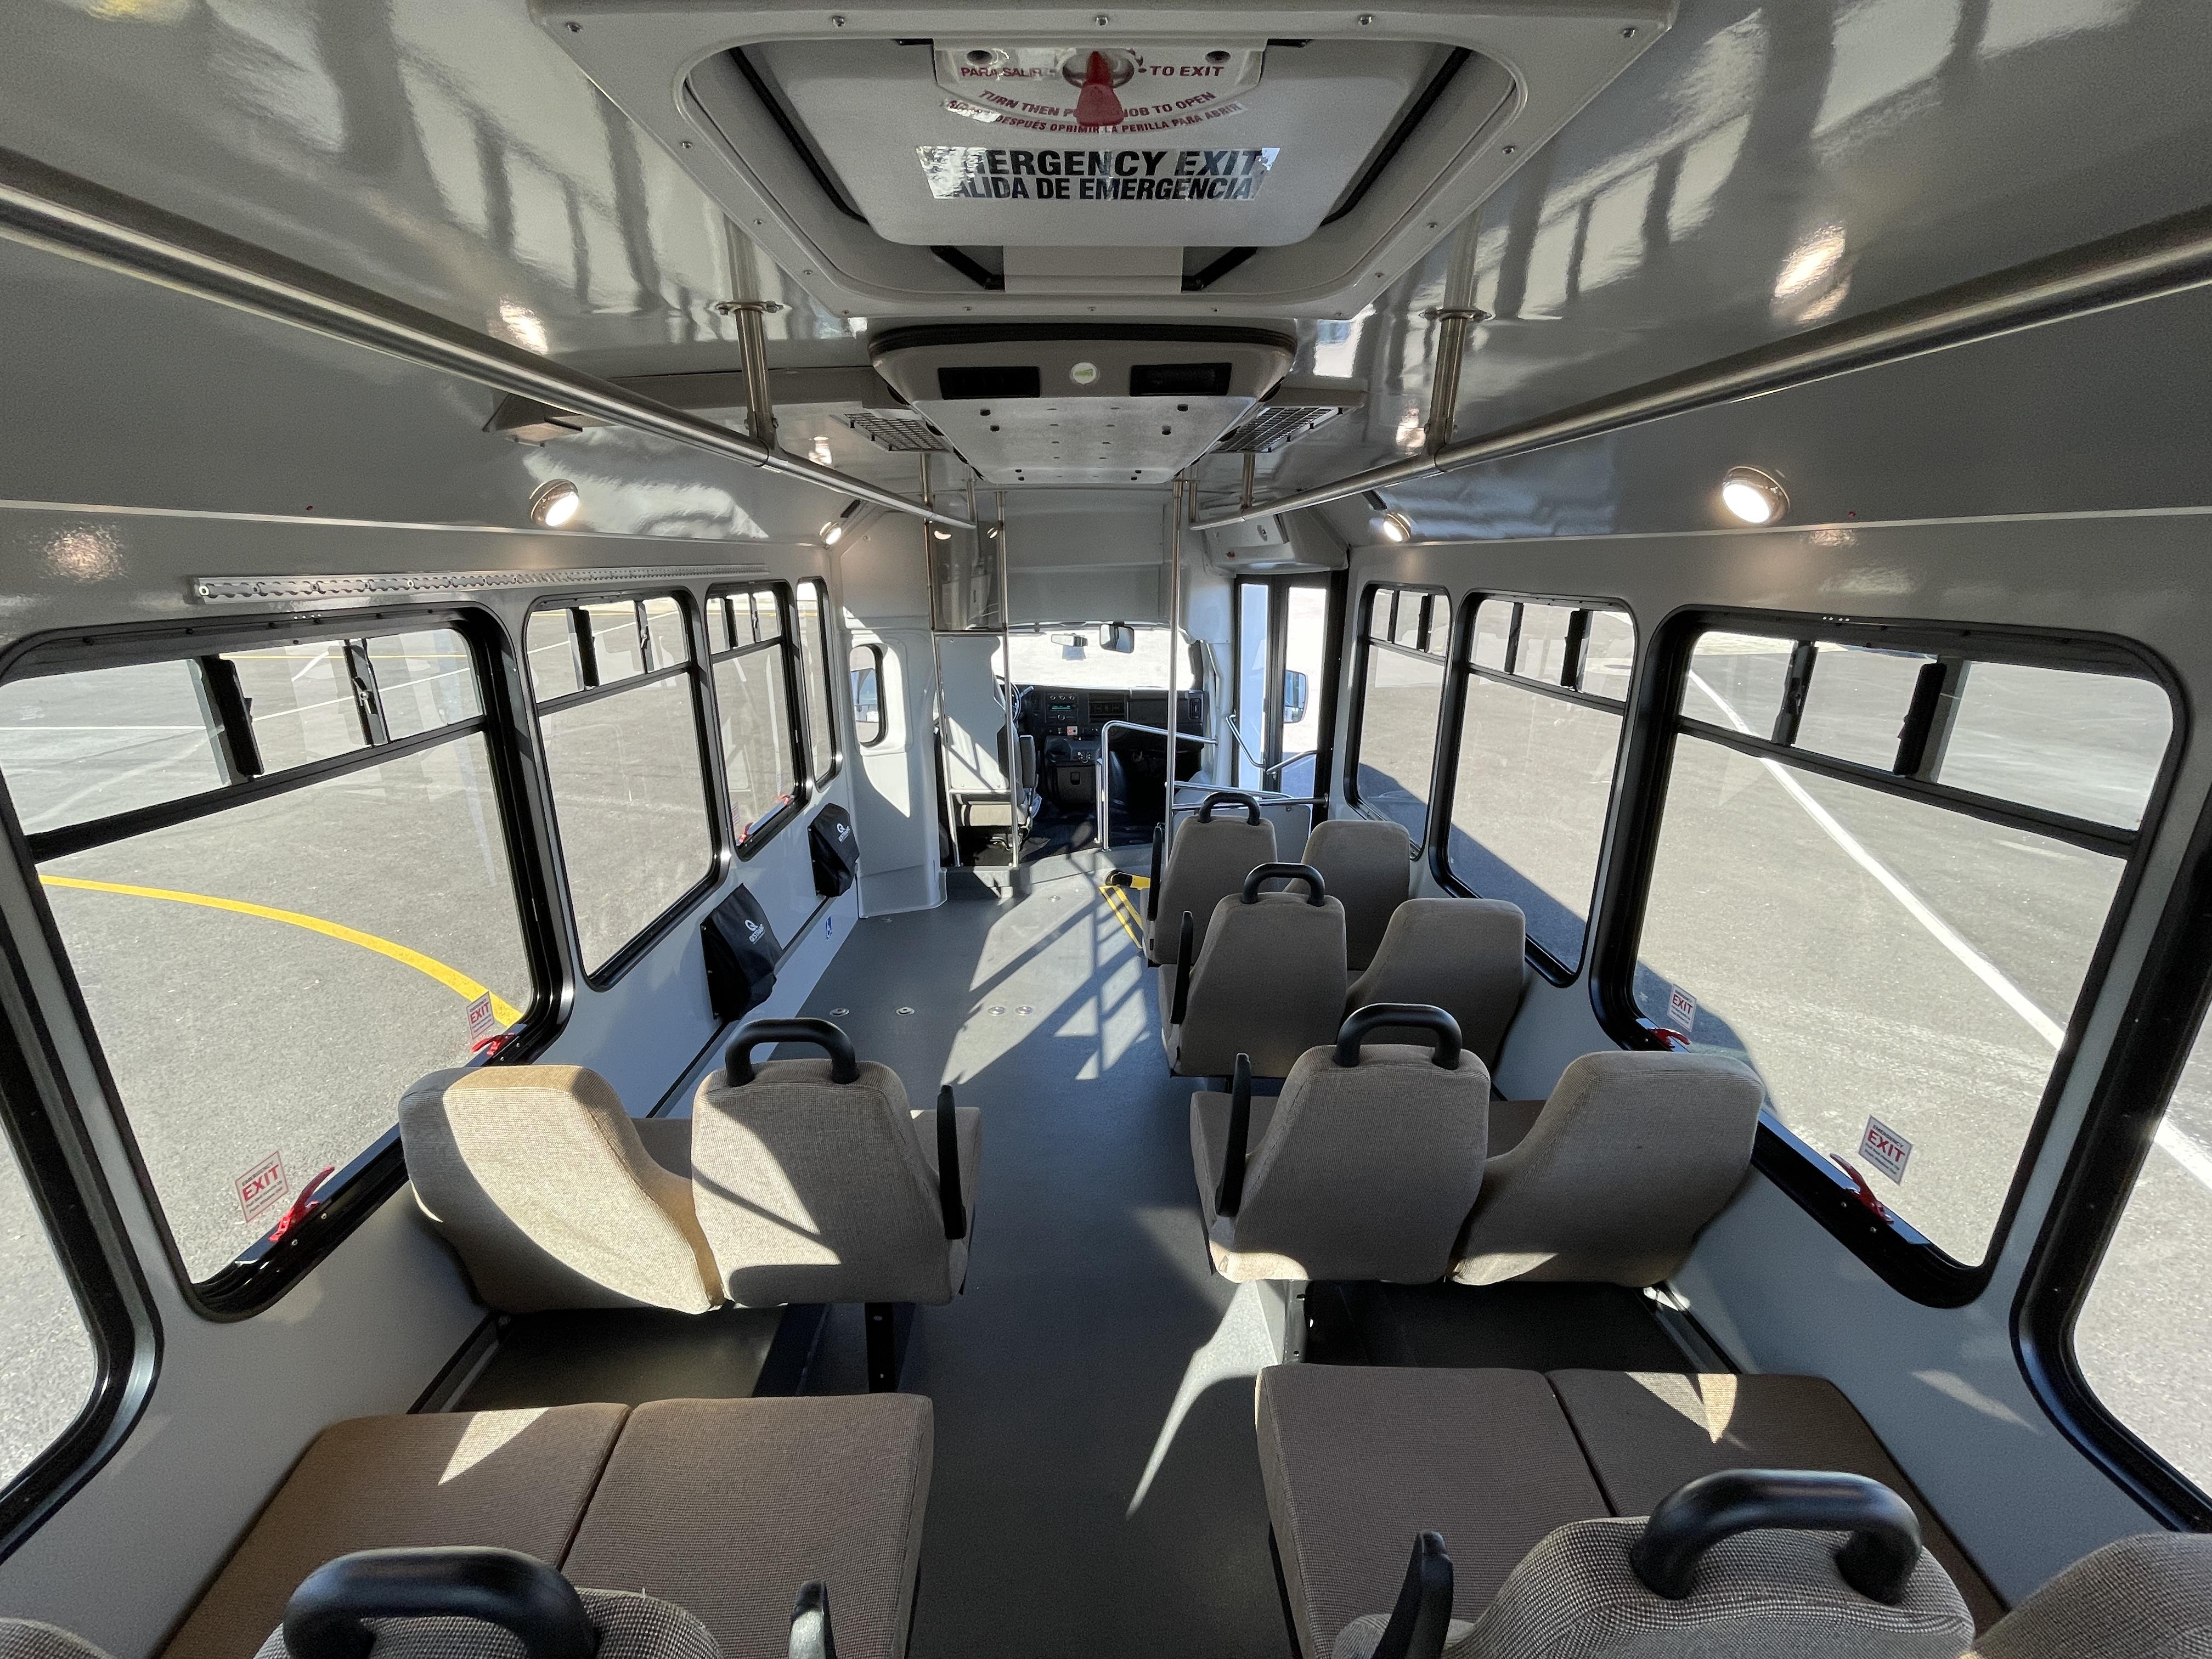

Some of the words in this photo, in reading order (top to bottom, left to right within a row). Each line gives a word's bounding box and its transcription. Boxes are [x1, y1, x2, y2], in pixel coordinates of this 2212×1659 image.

[1150, 65, 1175, 76] TO
[1180, 65, 1224, 76] EXIT
[979, 89, 1019, 109] TURN
[1022, 102, 1060, 117] THEN
[1124, 106, 1150, 117] OB
[1152, 103, 1173, 114] TO
[1175, 92, 1216, 109] OPEN
[995, 114, 1047, 131] DESPUÉS
[1049, 123, 1099, 133] OPRIMIR
[1121, 120, 1169, 133] PERILLA
[1171, 115, 1203, 127] PARA
[1204, 103, 1242, 120] ABRIR
[1174, 150, 1263, 176] EXIT
[938, 177, 1030, 199] ALIDA
[1036, 177, 1070, 199] DE
[1079, 177, 1252, 200] EMERGENCIA
[470, 1001, 489, 1024] EXIT
[1672, 994, 1693, 1014] EXIT
[1867, 1128, 1905, 1163] EXIT
[242, 1164, 279, 1202] EXIT
